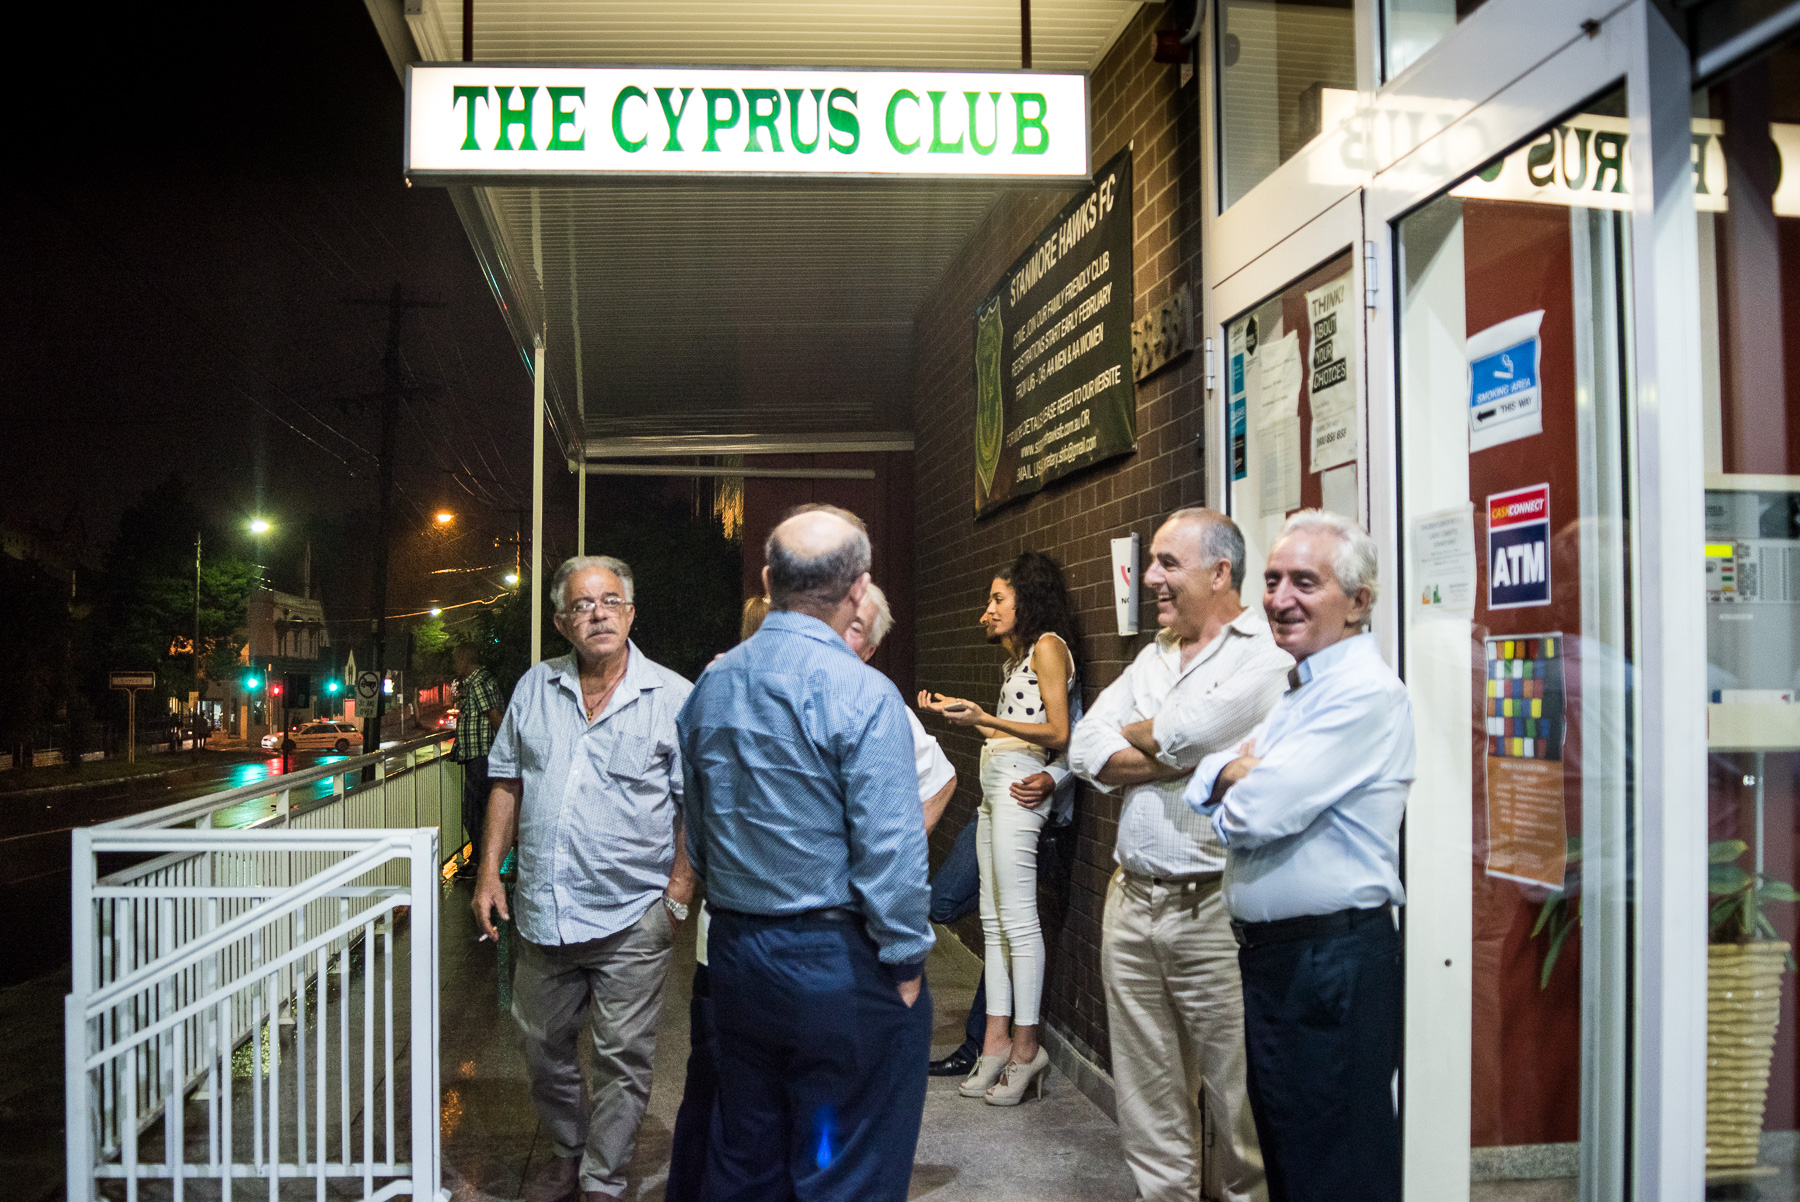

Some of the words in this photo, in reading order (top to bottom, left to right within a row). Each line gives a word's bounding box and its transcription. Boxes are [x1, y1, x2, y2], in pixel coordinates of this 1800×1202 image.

[453, 86, 586, 152] THE
[611, 85, 860, 155] CYPRUS
[885, 88, 1050, 156] CLUB
[1010, 232, 1058, 308] STANMORE
[1058, 192, 1097, 260] HAWKS
[1100, 173, 1116, 221] FC
[1036, 304, 1048, 329] OUR
[1047, 287, 1066, 319] FAMILY
[1065, 264, 1092, 305] FRIENDLY
[1091, 250, 1110, 281] CLUB
[1312, 285, 1345, 317] THINK!
[1045, 321, 1062, 350] START
[1061, 307, 1079, 338] EARLY
[1079, 281, 1113, 324] FEBRUARY
[1316, 315, 1337, 341] ABOUT
[1054, 347, 1067, 372] MEN
[1080, 322, 1104, 355] WOMEN
[1315, 343, 1333, 364] YOUR
[1057, 391, 1074, 415] REFER
[1074, 387, 1082, 406] TO
[1081, 380, 1095, 402] OUR
[1094, 364, 1122, 394] WEBSITE
[1314, 362, 1346, 389] CHOICES
[1477, 383, 1509, 404] SMOKING
[1511, 377, 1531, 393] AREA
[1080, 408, 1091, 428] OR
[1501, 401, 1516, 414] THIS
[1518, 396, 1533, 409] WAY
[1492, 540, 1546, 589] ATM
